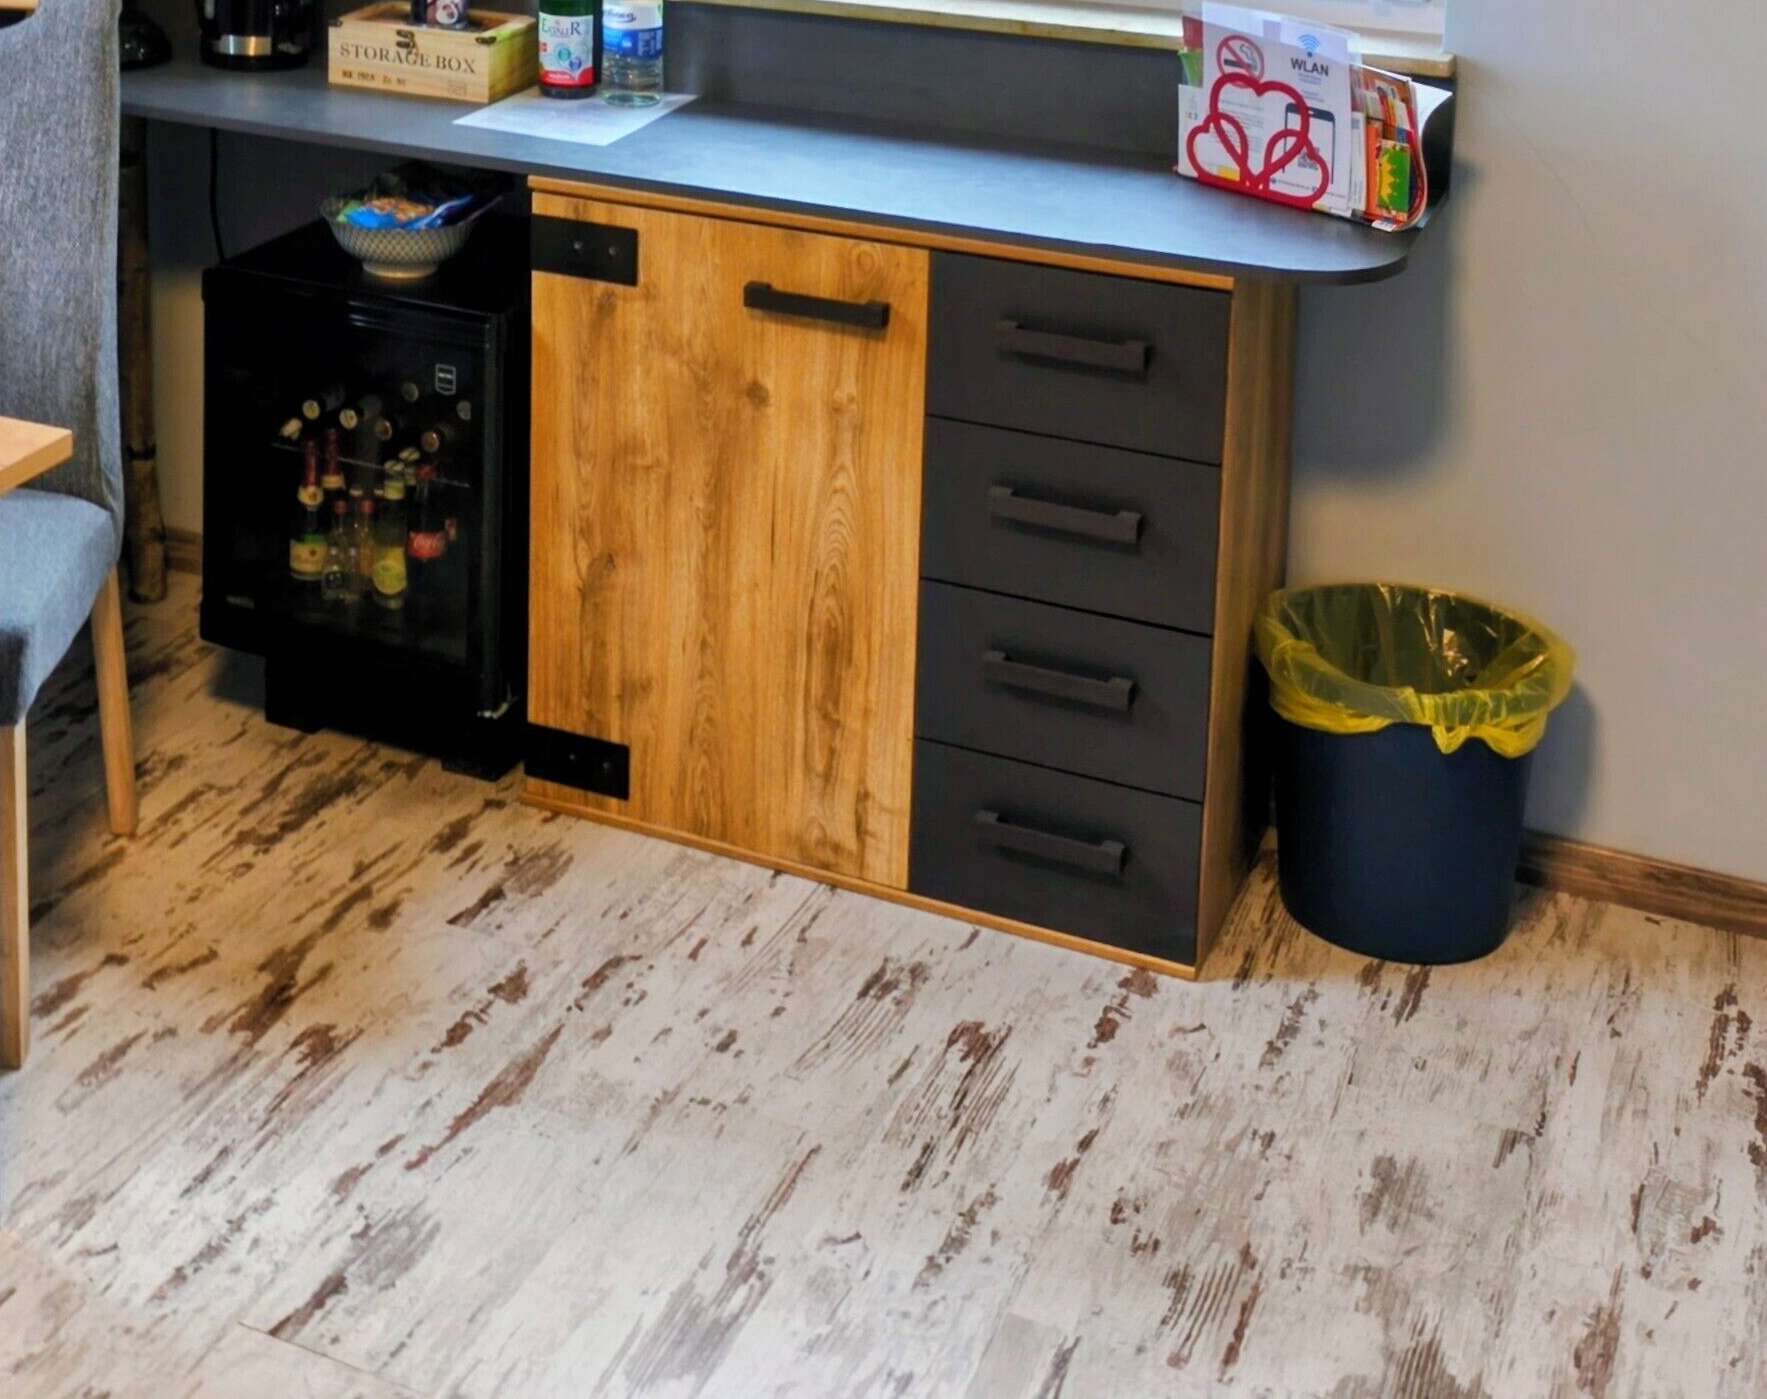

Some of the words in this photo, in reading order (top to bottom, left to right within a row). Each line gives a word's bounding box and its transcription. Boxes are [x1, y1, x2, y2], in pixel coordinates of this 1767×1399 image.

[340, 42, 431, 68] STORAGE
[436, 54, 476, 74] BOX
[1290, 57, 1329, 77] WLAN
